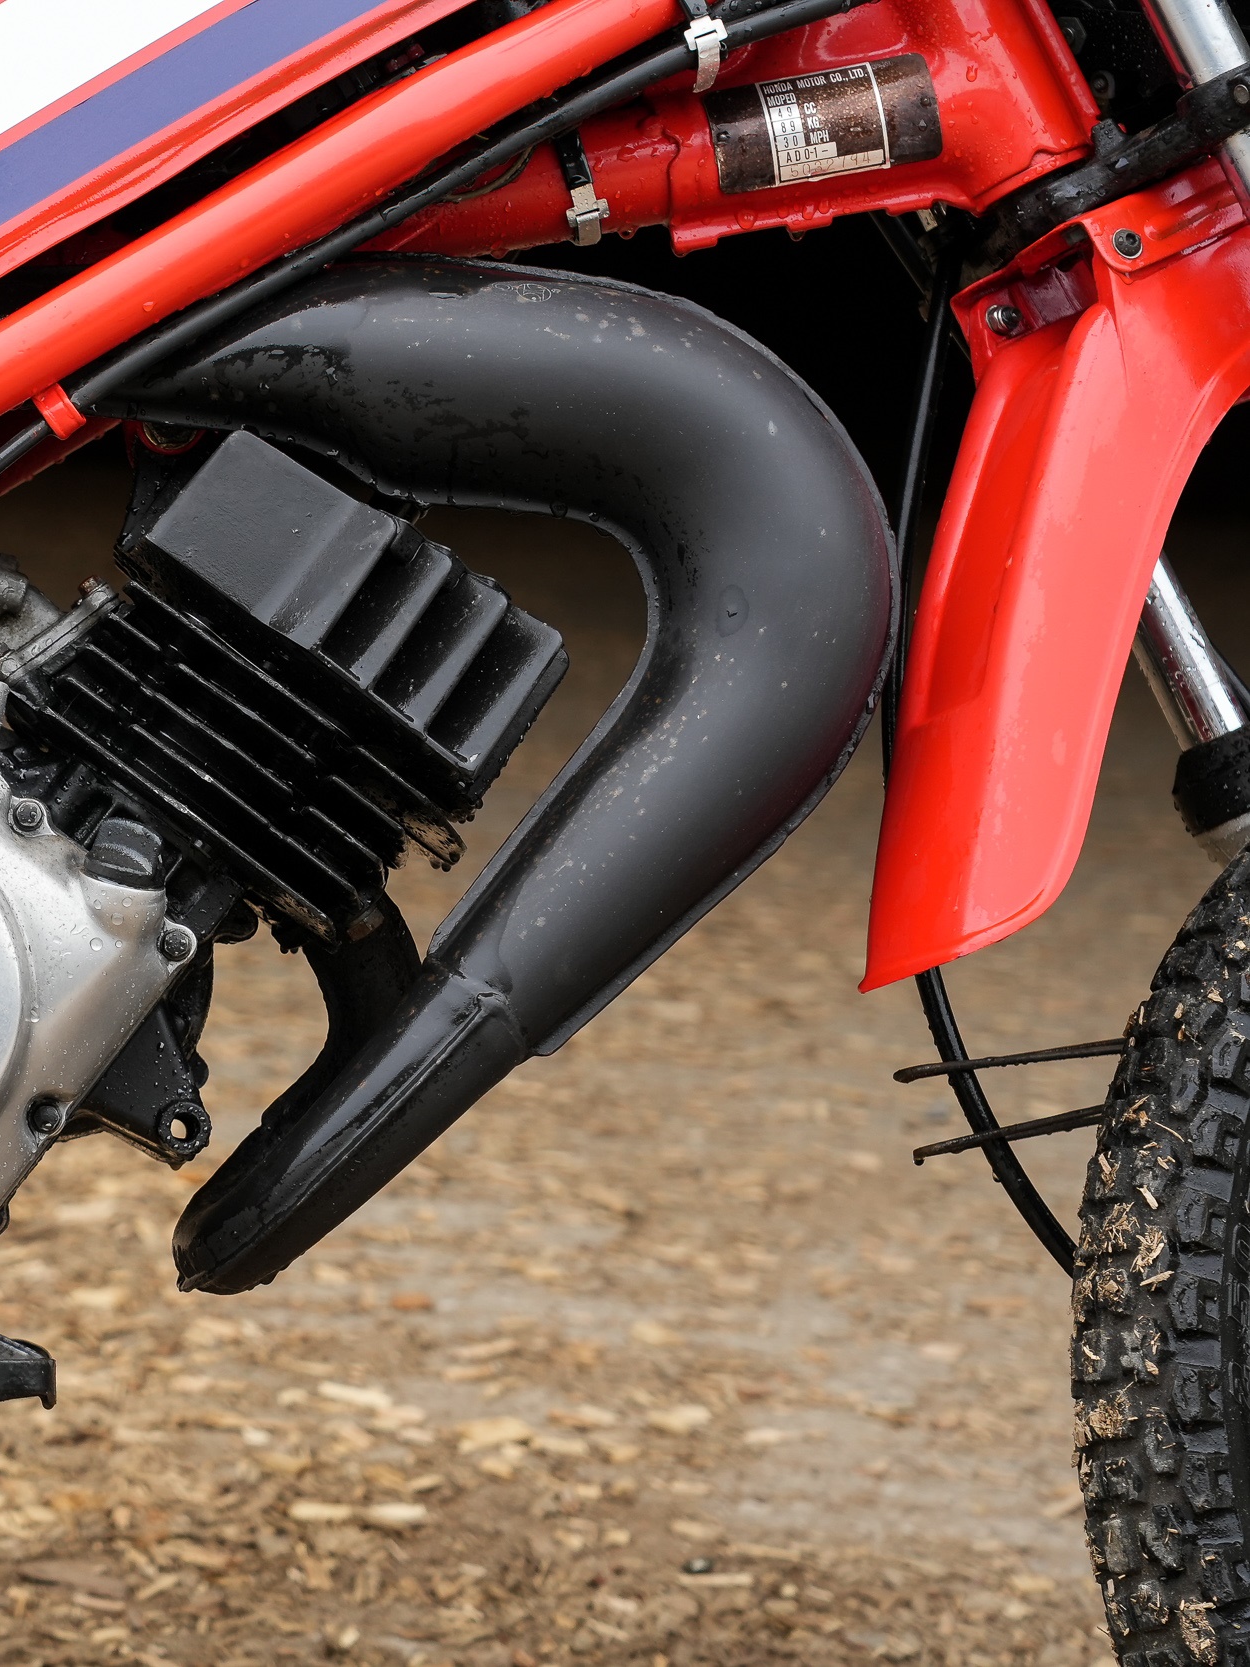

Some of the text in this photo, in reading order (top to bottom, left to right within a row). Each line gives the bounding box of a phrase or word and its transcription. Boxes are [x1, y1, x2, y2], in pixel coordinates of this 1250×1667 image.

[763, 82, 793, 95] HONDA
[796, 75, 827, 89] MOTOR
[766, 92, 797, 107] MOPED
[778, 102, 817, 118] 49 CC
[781, 116, 820, 133] 89 KG
[783, 130, 829, 148] 30 MPH
